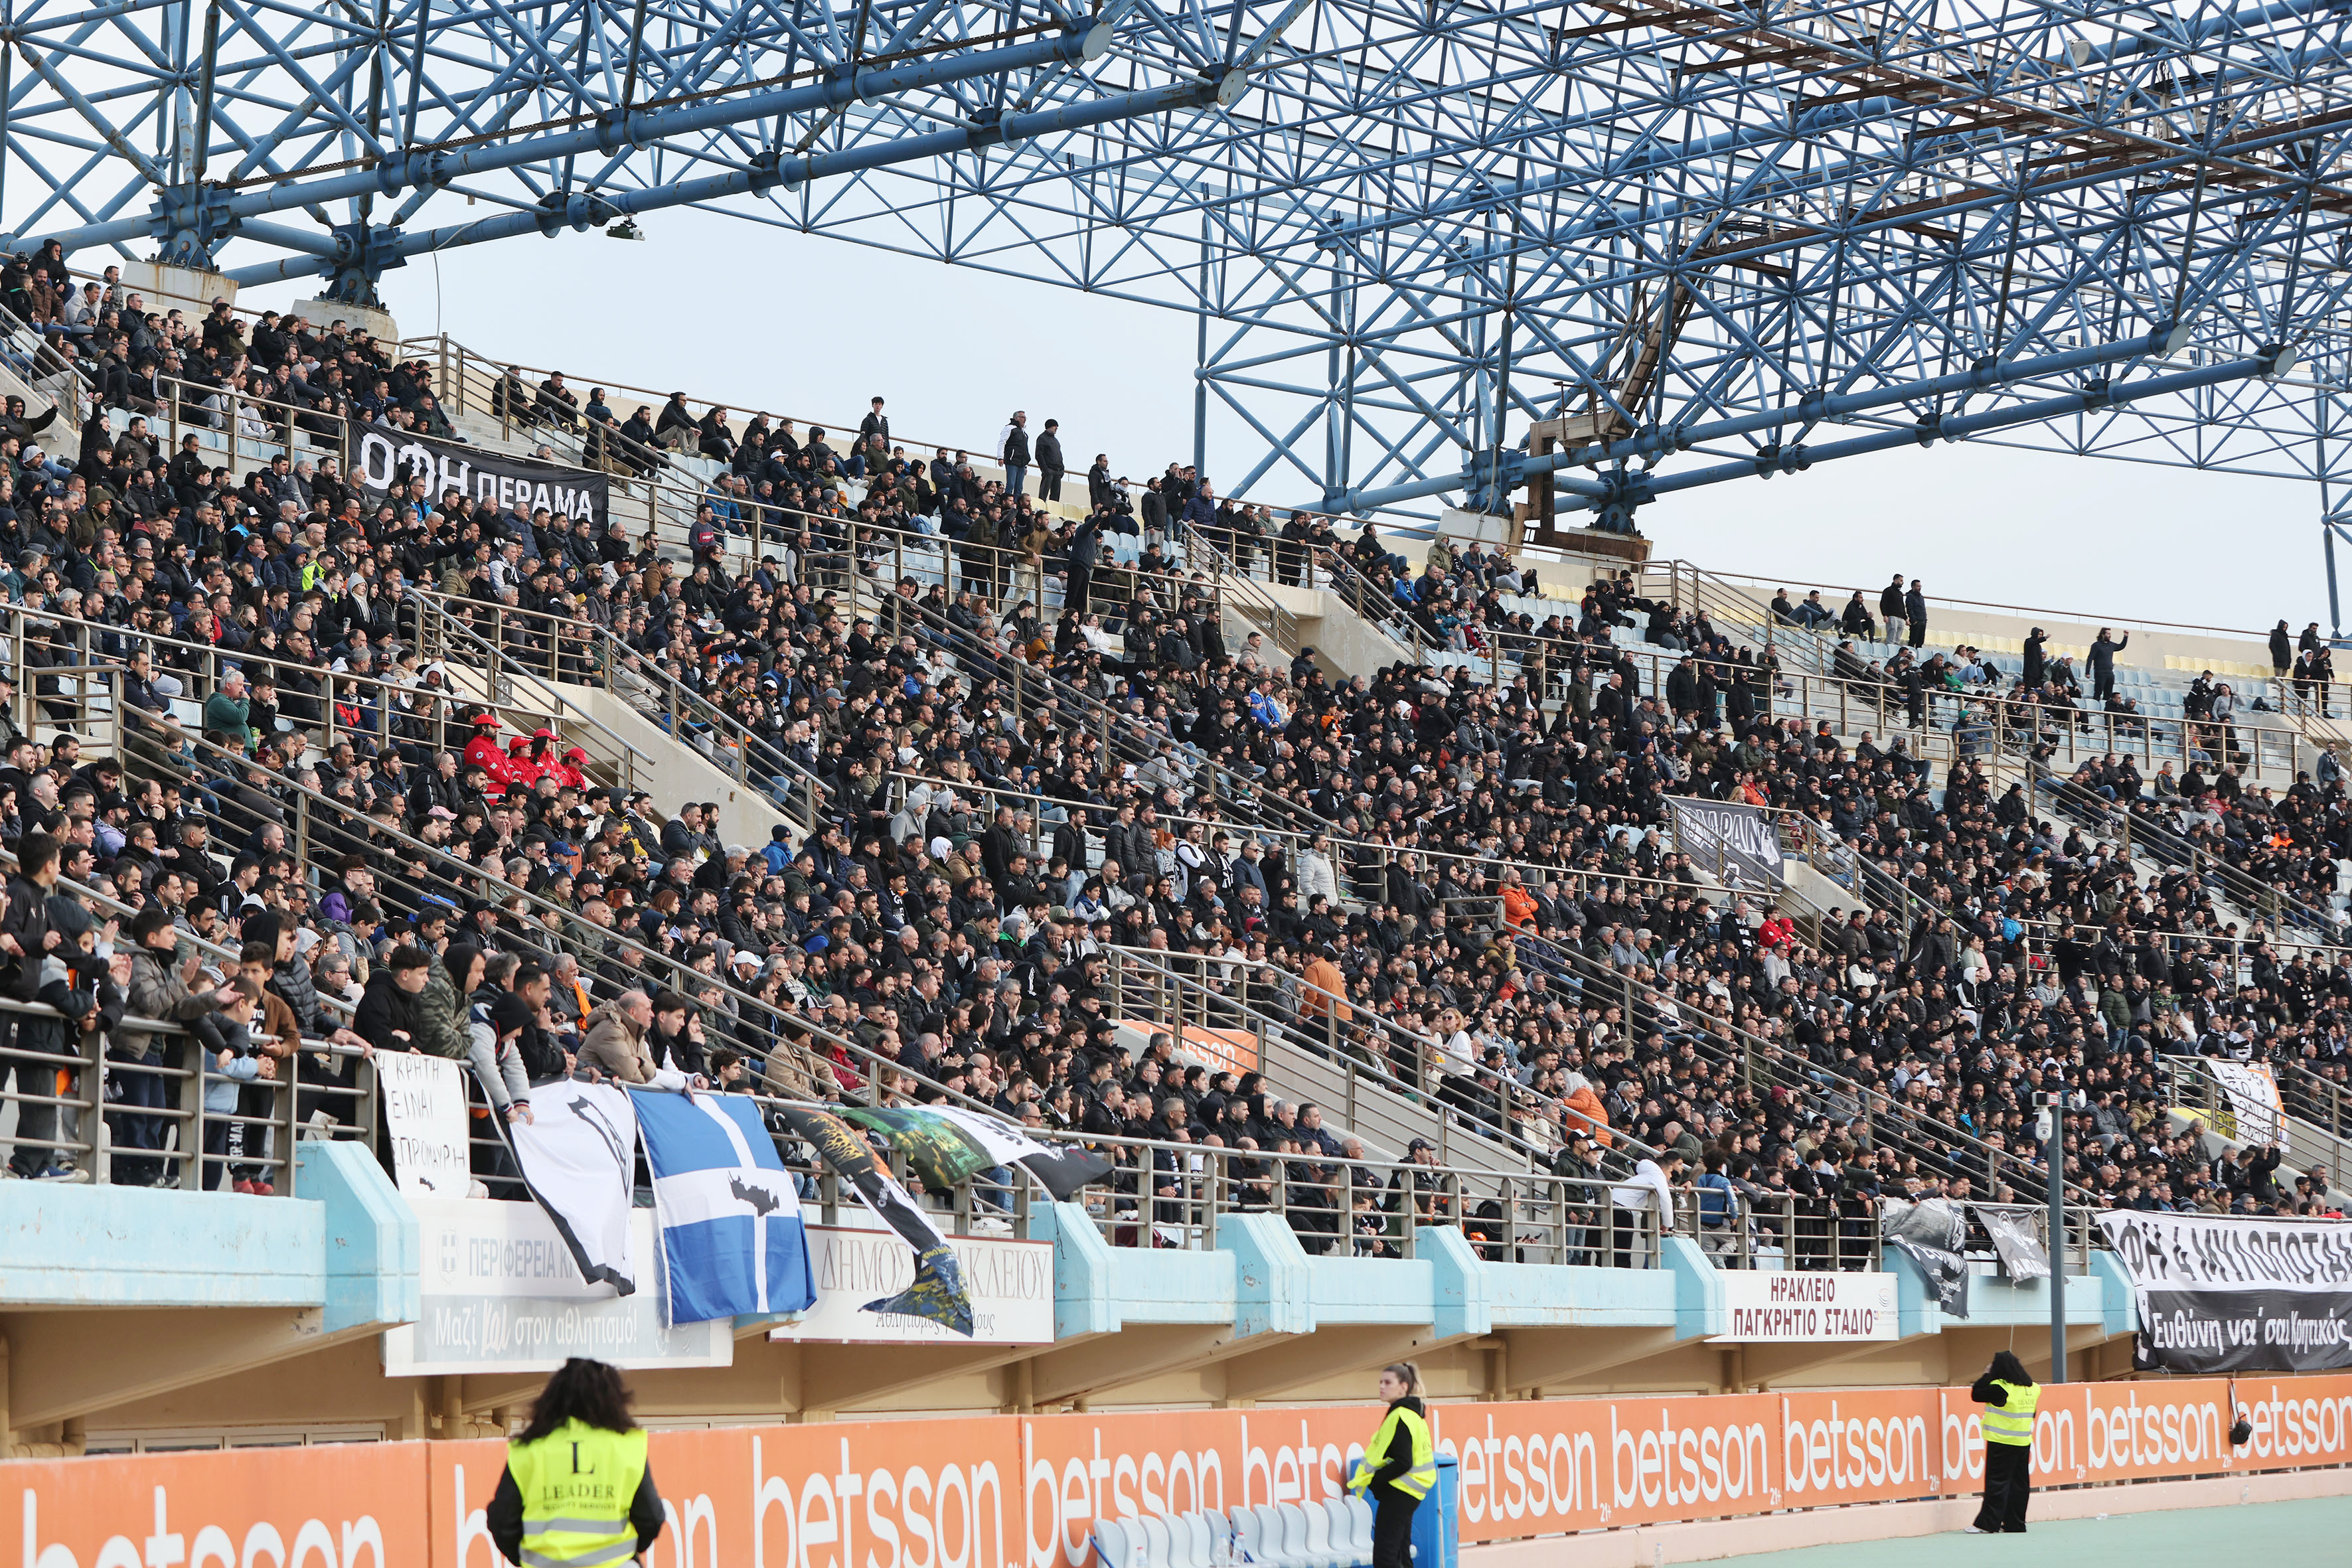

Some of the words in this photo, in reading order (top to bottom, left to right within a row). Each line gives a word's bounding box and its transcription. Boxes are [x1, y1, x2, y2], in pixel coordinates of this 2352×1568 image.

[360, 432, 472, 506] ΟΦΗ
[477, 471, 594, 523] ΠΕΡΑΜΑ
[396, 1057, 439, 1081] ΚΡΗΤΗ
[391, 1089, 433, 1120] ΕΙΝΑΙ
[469, 1237, 556, 1279] ΠΕΡΙΦΕΡΕΙΑ
[821, 1238, 911, 1294] ΔΗΜΟΣ
[1770, 1277, 1835, 1302] ΗΡΑΚΛΕΙΟ
[435, 1304, 477, 1355] Μαζί
[515, 1316, 552, 1345] στον
[556, 1304, 637, 1354] αθλητισμό!
[1734, 1308, 1816, 1336] ΠΑΓΚΡΗΤΙΟ
[1824, 1308, 1873, 1335] ΣΤΑΔΙΟ
[2152, 1308, 2224, 1356] Ευθύνη
[2290, 1308, 2352, 1354] Κρητικός
[1784, 1397, 1929, 1493] betsson
[2086, 1388, 2223, 1469] betsson
[567, 1439, 595, 1476] L
[1610, 1405, 1768, 1509] betsson
[542, 1483, 616, 1500] LEADER
[753, 1435, 1004, 1568] betsson
[1599, 1502, 1612, 1522] 21+
[1770, 1487, 1782, 1506] 21+
